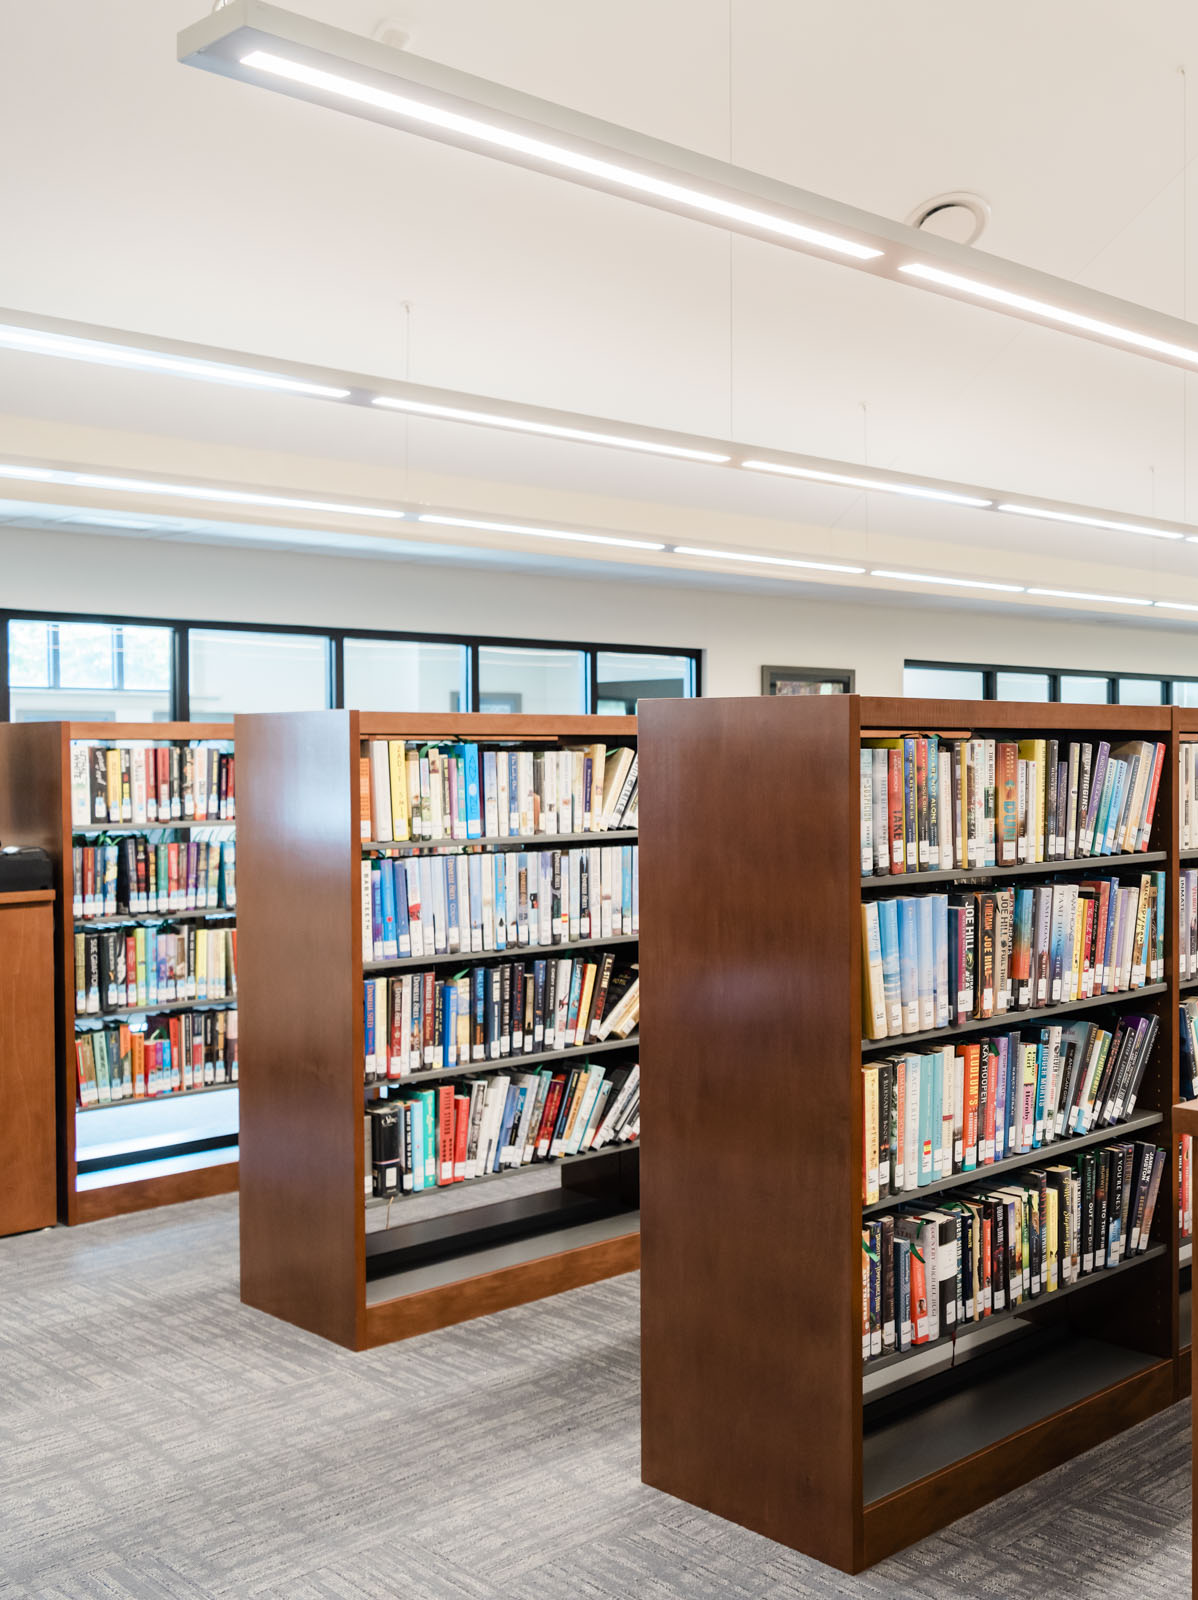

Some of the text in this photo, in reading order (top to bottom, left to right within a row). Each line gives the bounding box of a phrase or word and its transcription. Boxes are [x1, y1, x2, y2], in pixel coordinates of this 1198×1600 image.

[1081, 774, 1089, 811] HIGGINS
[893, 809, 902, 840] TAKE
[1004, 801, 1016, 840] DUN
[965, 902, 974, 951] JOE HILL
[984, 936, 992, 976] JOE HILL
[970, 1054, 979, 1105] LUDLUM'S
